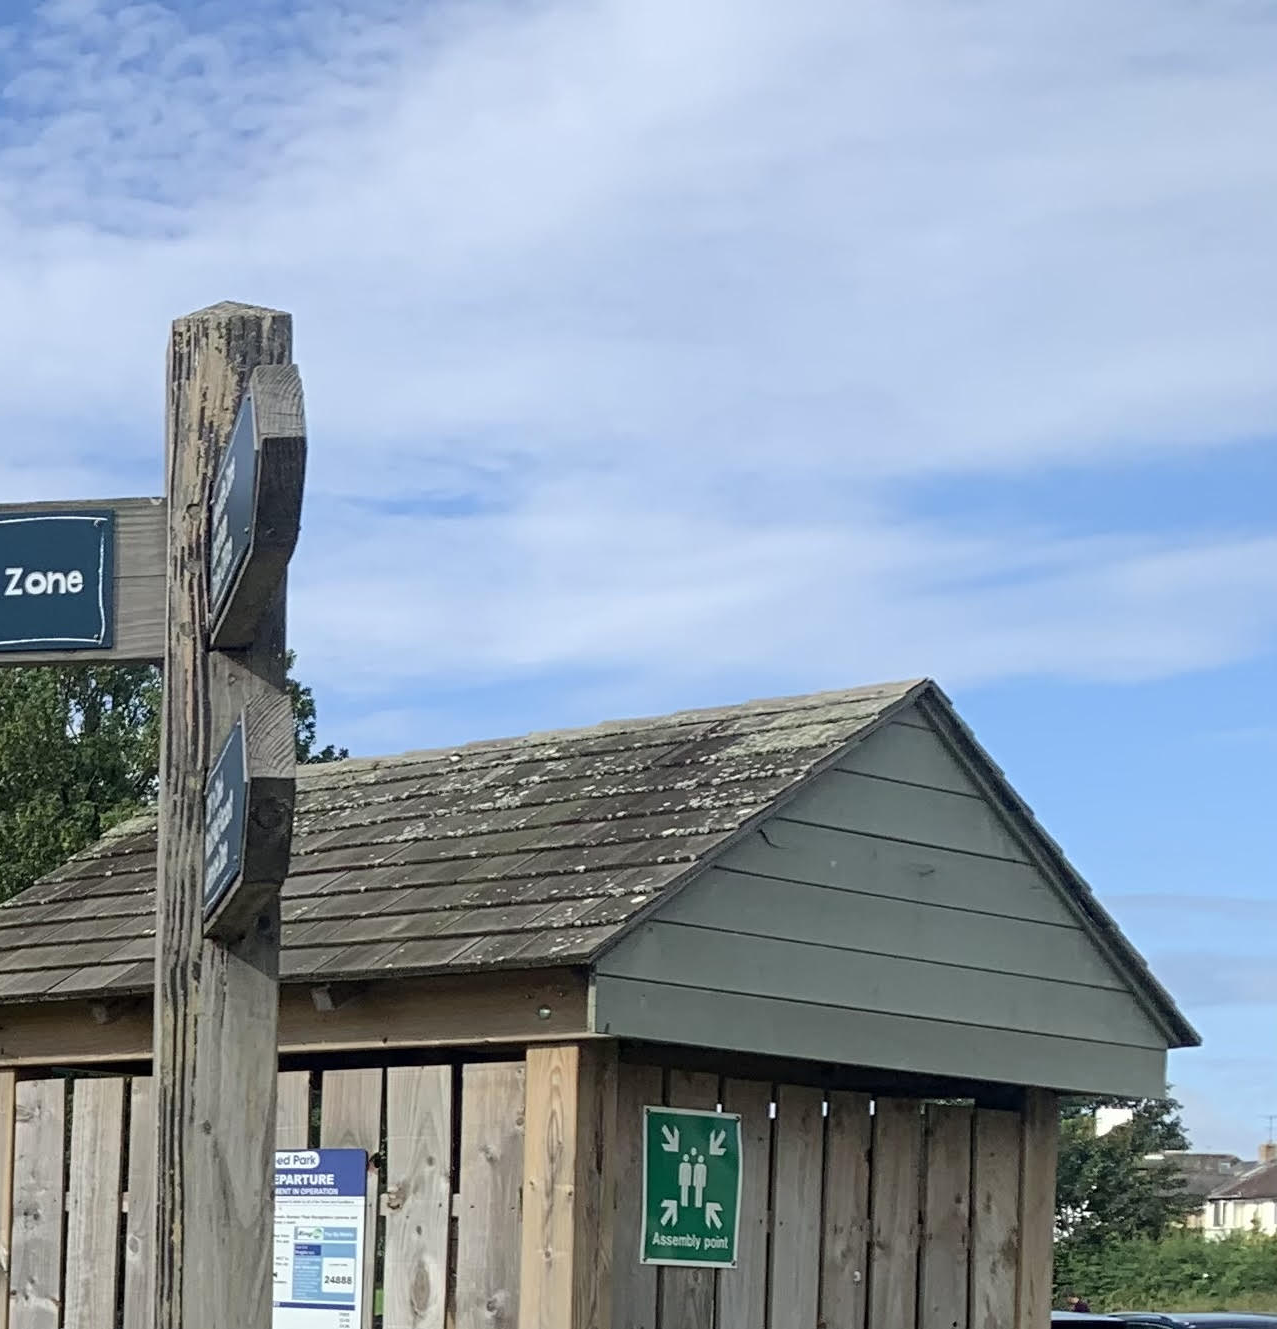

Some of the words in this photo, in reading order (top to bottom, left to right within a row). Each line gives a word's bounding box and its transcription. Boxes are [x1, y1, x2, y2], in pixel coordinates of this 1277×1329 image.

[4, 567, 84, 596] Zone
[293, 1155, 316, 1165] Park
[275, 1174, 335, 1186] EPARTURE
[652, 1231, 702, 1250] Assembly
[704, 1235, 729, 1250] point
[324, 1275, 353, 1285] 24888
